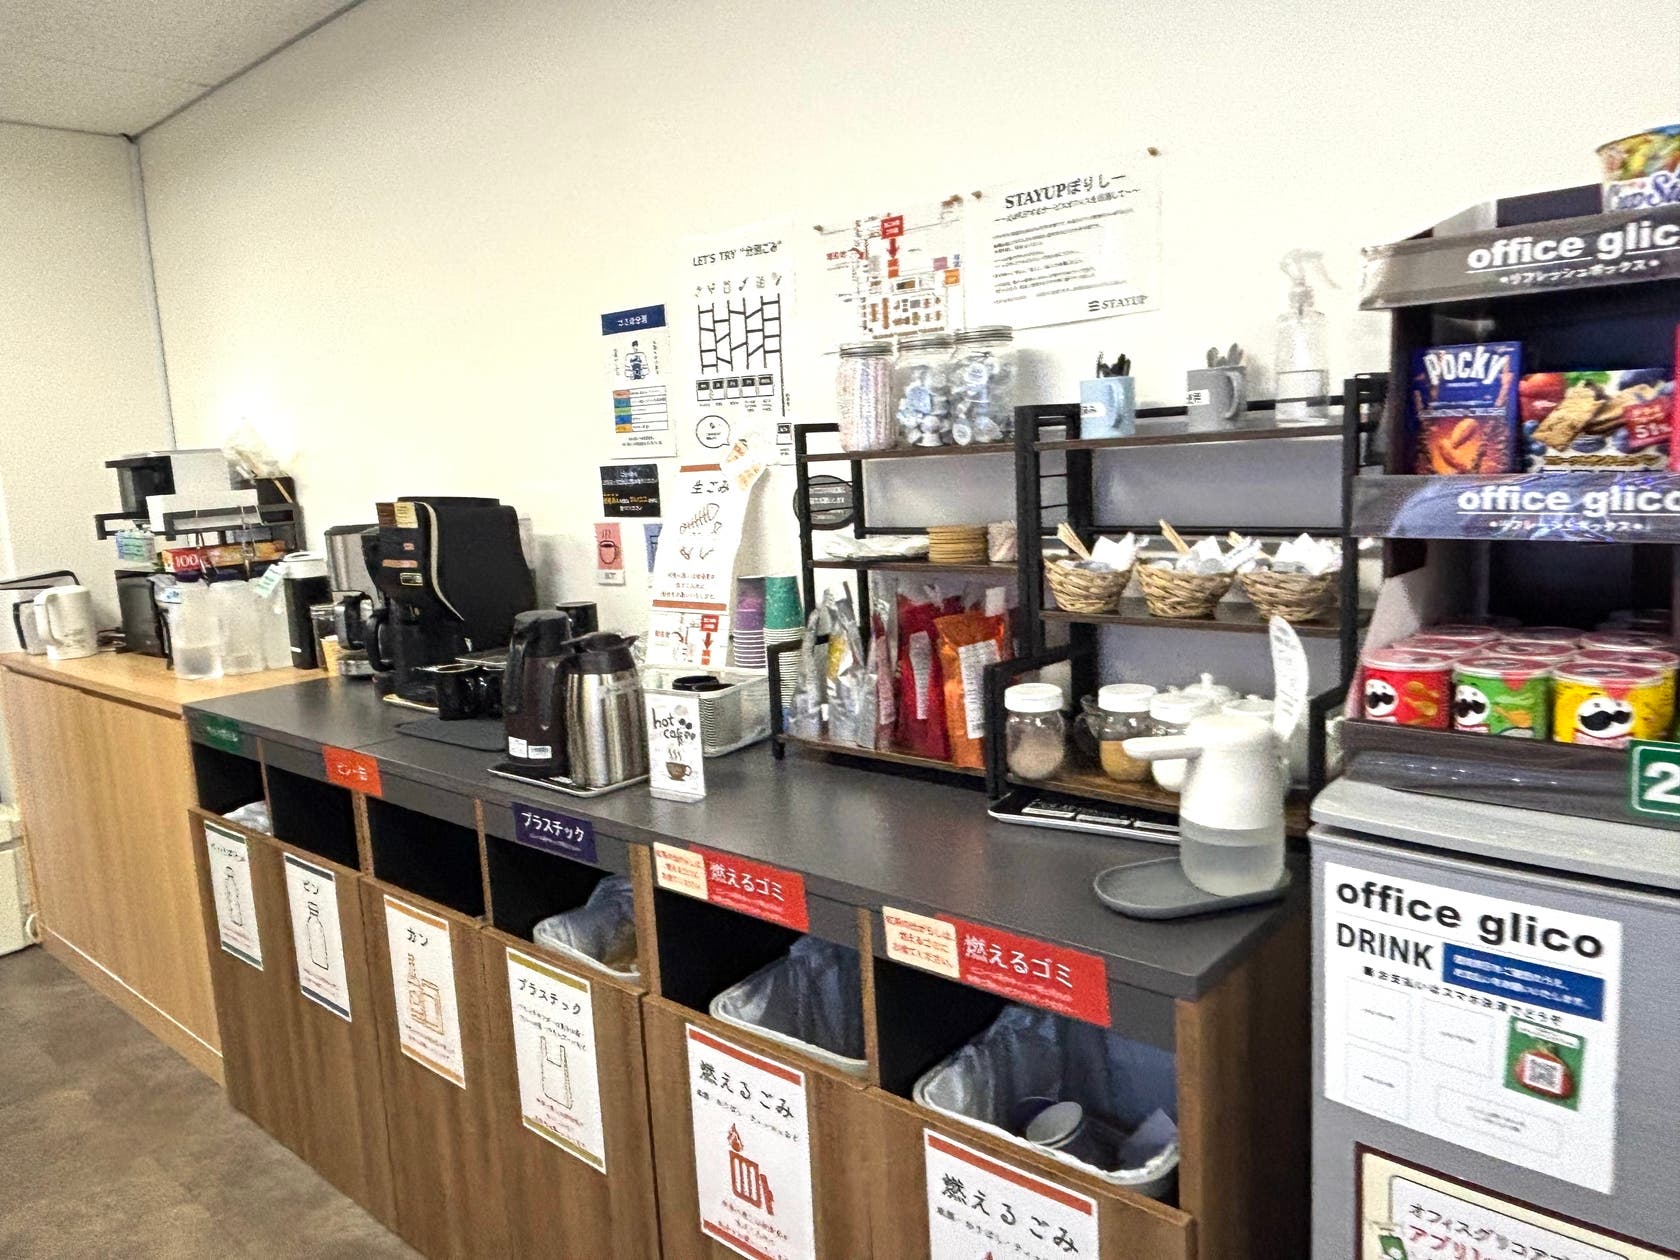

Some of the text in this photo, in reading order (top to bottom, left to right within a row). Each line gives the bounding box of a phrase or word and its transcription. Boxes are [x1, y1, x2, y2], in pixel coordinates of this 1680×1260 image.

[692, 252, 717, 267] LET'S
[718, 248, 737, 261] TRY
[1466, 236, 1586, 269] office
[1456, 484, 1571, 511] office
[651, 707, 675, 730] hot
[520, 812, 585, 842] プラスチック
[709, 861, 785, 902] 燃えるゴミ
[1336, 880, 1605, 960] office glico
[964, 934, 1073, 989] 燃えるゴミ
[1336, 922, 1434, 971] DRINK
[517, 978, 582, 1015] プラスチック
[699, 1059, 795, 1119] 燃えるごみ
[941, 1172, 1080, 1254] 燃えるごみ
